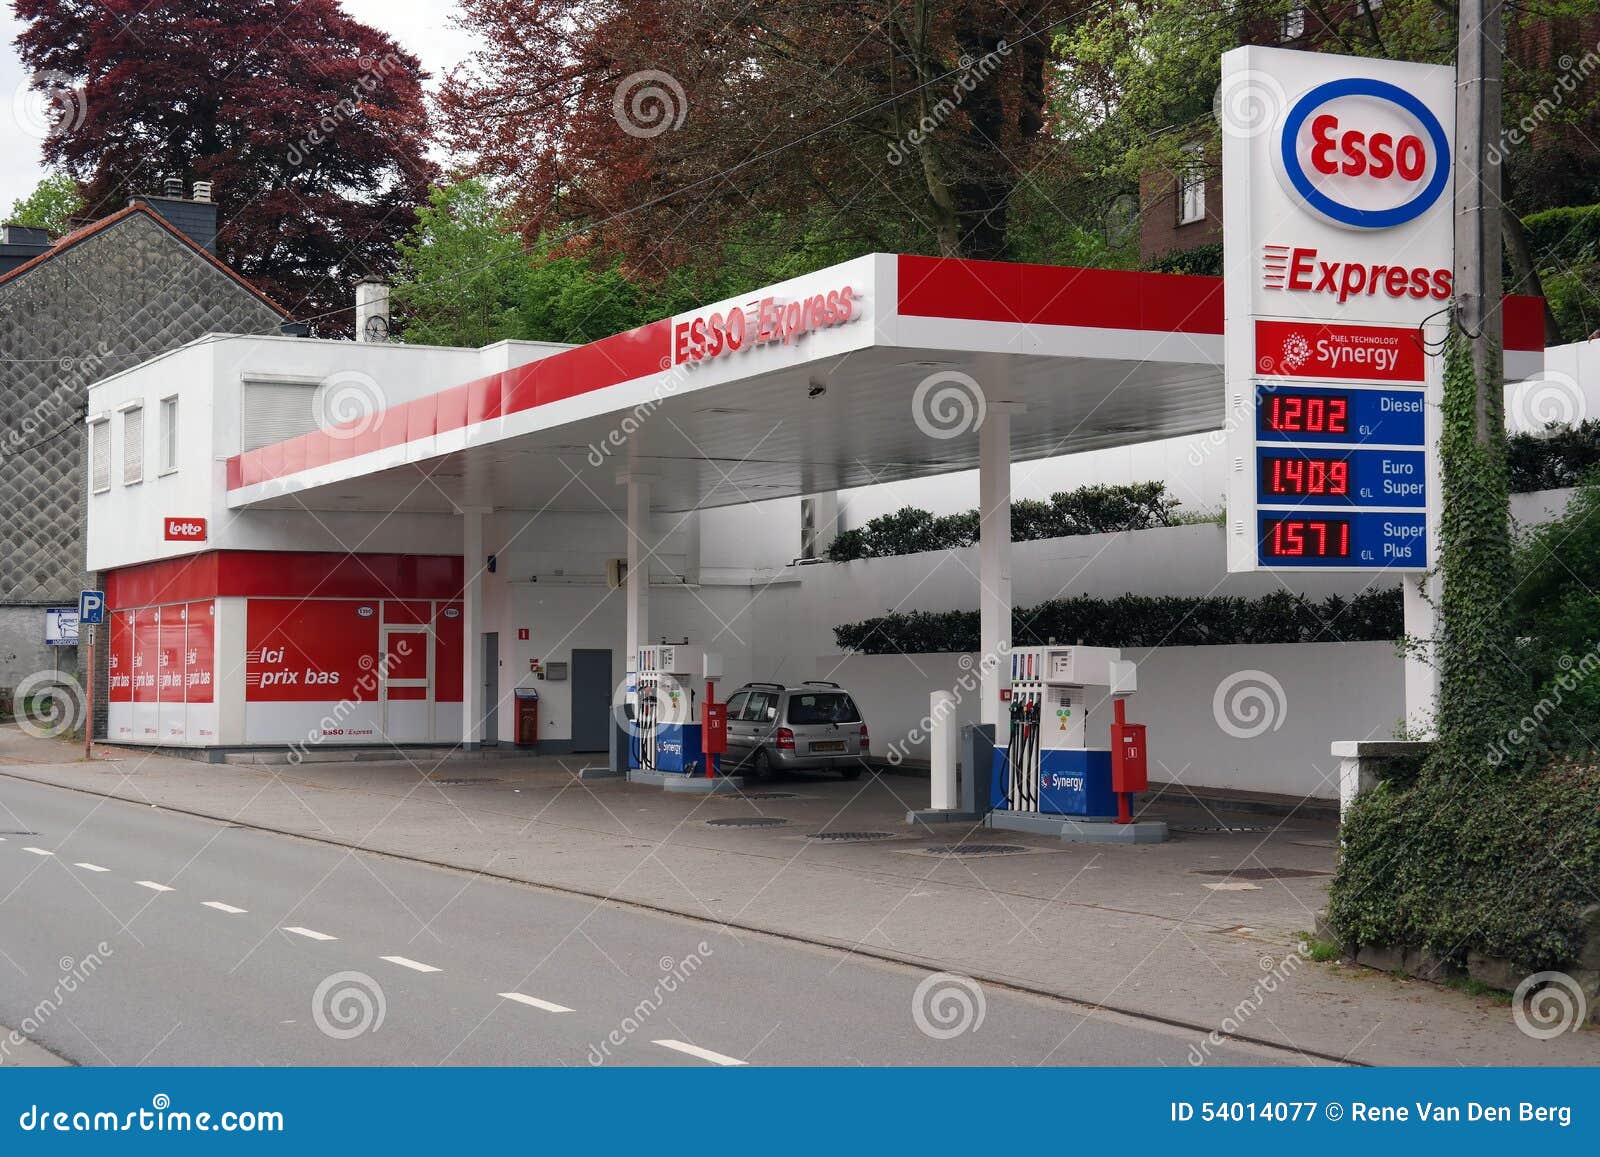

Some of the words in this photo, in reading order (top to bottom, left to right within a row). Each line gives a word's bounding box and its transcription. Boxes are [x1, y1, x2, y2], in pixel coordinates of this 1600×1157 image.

[1287, 247, 1453, 303] Express
[759, 286, 854, 346] Express
[1330, 335, 1349, 343] FUEL
[1351, 335, 1399, 345] TECHNOLOGY
[1317, 339, 1399, 370] Synergy
[1272, 397, 1348, 432] 1.202
[1380, 397, 1423, 413] Diesel
[1273, 460, 1348, 493] 1.409
[1382, 460, 1413, 474] Euro
[1383, 480, 1424, 497] Super
[1274, 523, 1348, 555] 1.571
[1383, 523, 1424, 540] Super
[1384, 543, 1412, 558] Plus
[83, 595, 101, 619] P
[259, 647, 284, 663] Ici
[260, 668, 298, 688] prix
[304, 667, 340, 685] bas
[1052, 773, 1083, 791] Synergy
